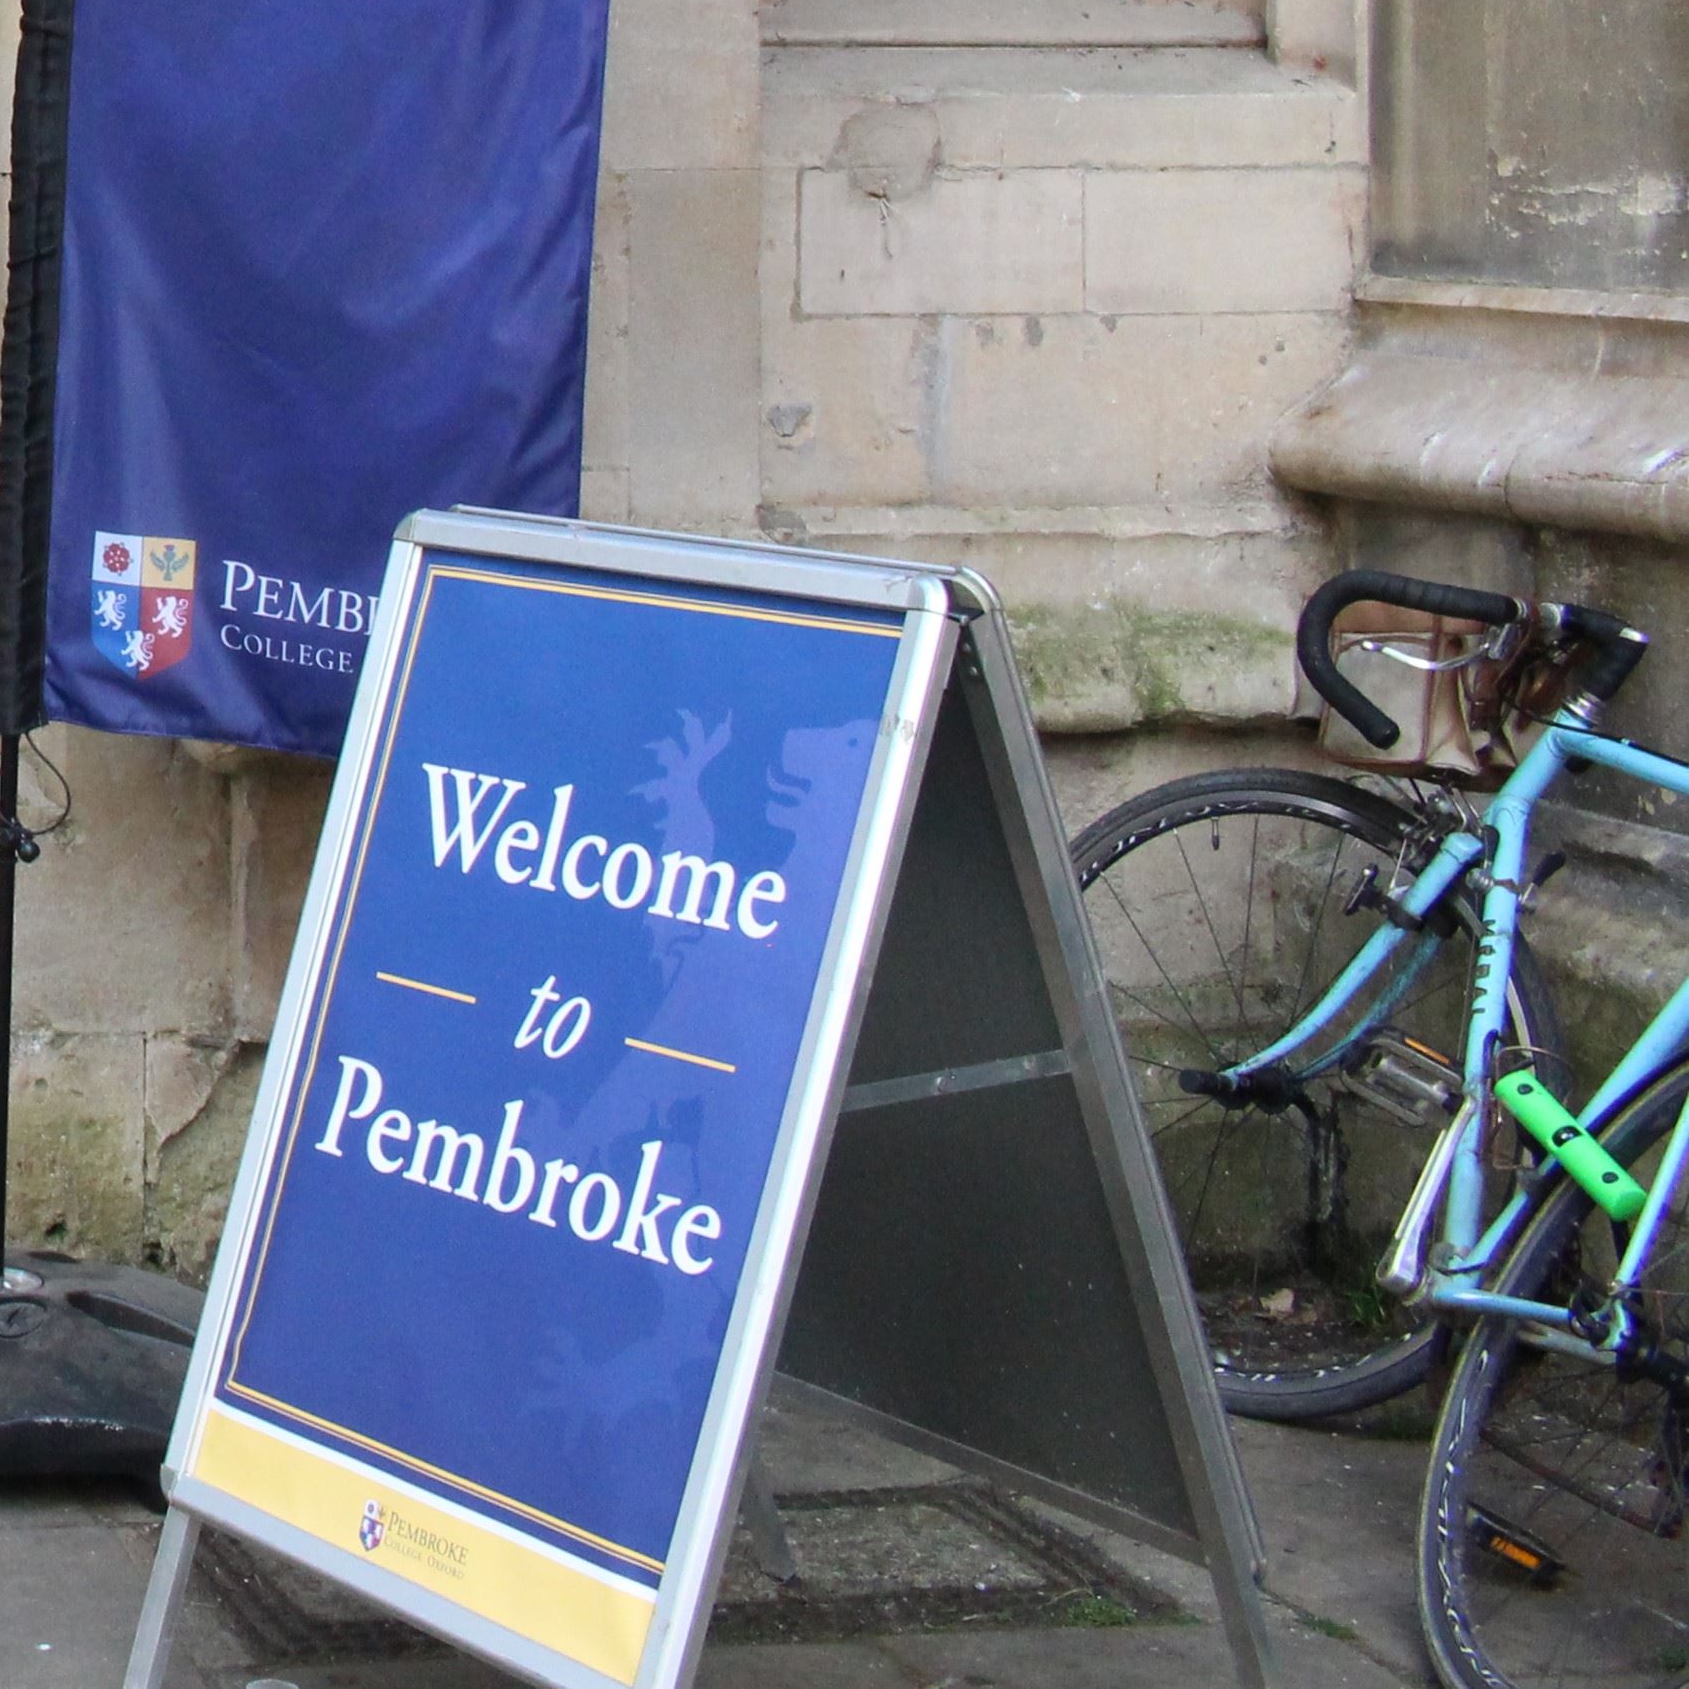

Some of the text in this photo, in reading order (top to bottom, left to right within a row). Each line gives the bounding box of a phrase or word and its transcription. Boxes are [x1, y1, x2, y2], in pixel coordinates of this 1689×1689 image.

[221, 623, 354, 673] COLLEGE
[422, 761, 786, 939] Welcome
[514, 974, 592, 1059] to
[315, 1055, 723, 1276] Pembroke
[388, 1511, 468, 1565] PEMBROKE
